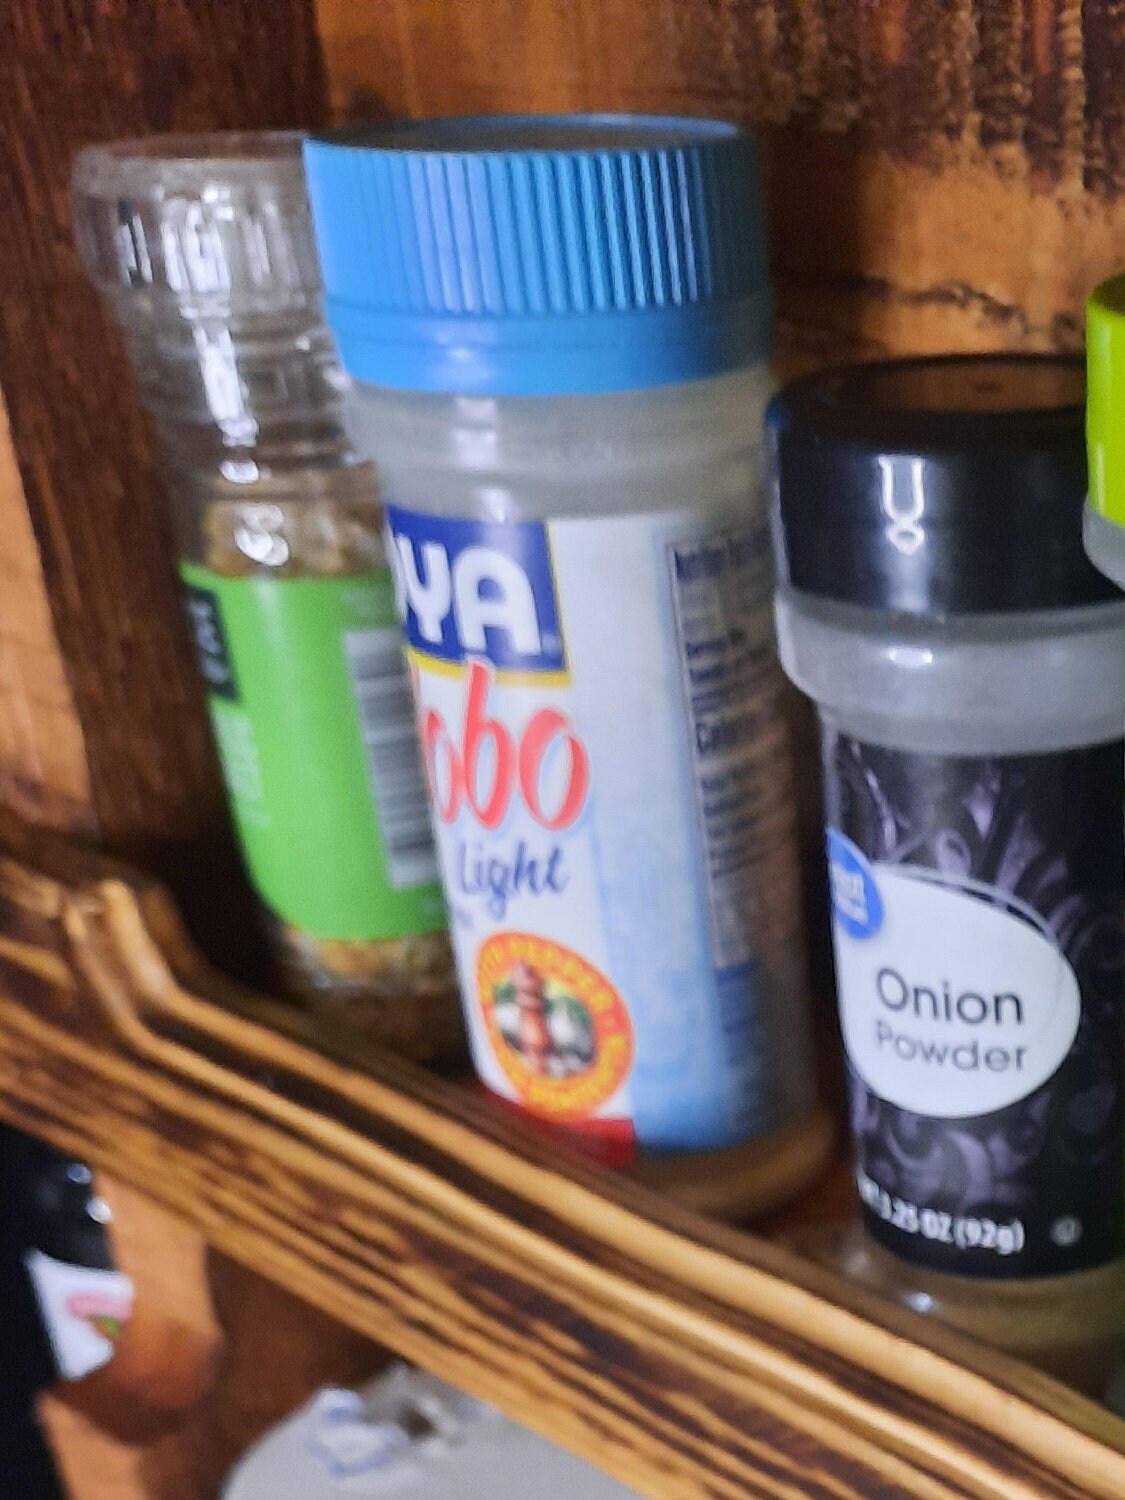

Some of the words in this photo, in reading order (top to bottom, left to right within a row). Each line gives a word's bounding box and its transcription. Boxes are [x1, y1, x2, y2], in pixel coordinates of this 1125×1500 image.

[457, 838, 570, 922] Light
[876, 967, 1025, 1027] Onion
[877, 1018, 1028, 1074] Powder
[953, 1217, 1025, 1255] (92g)
